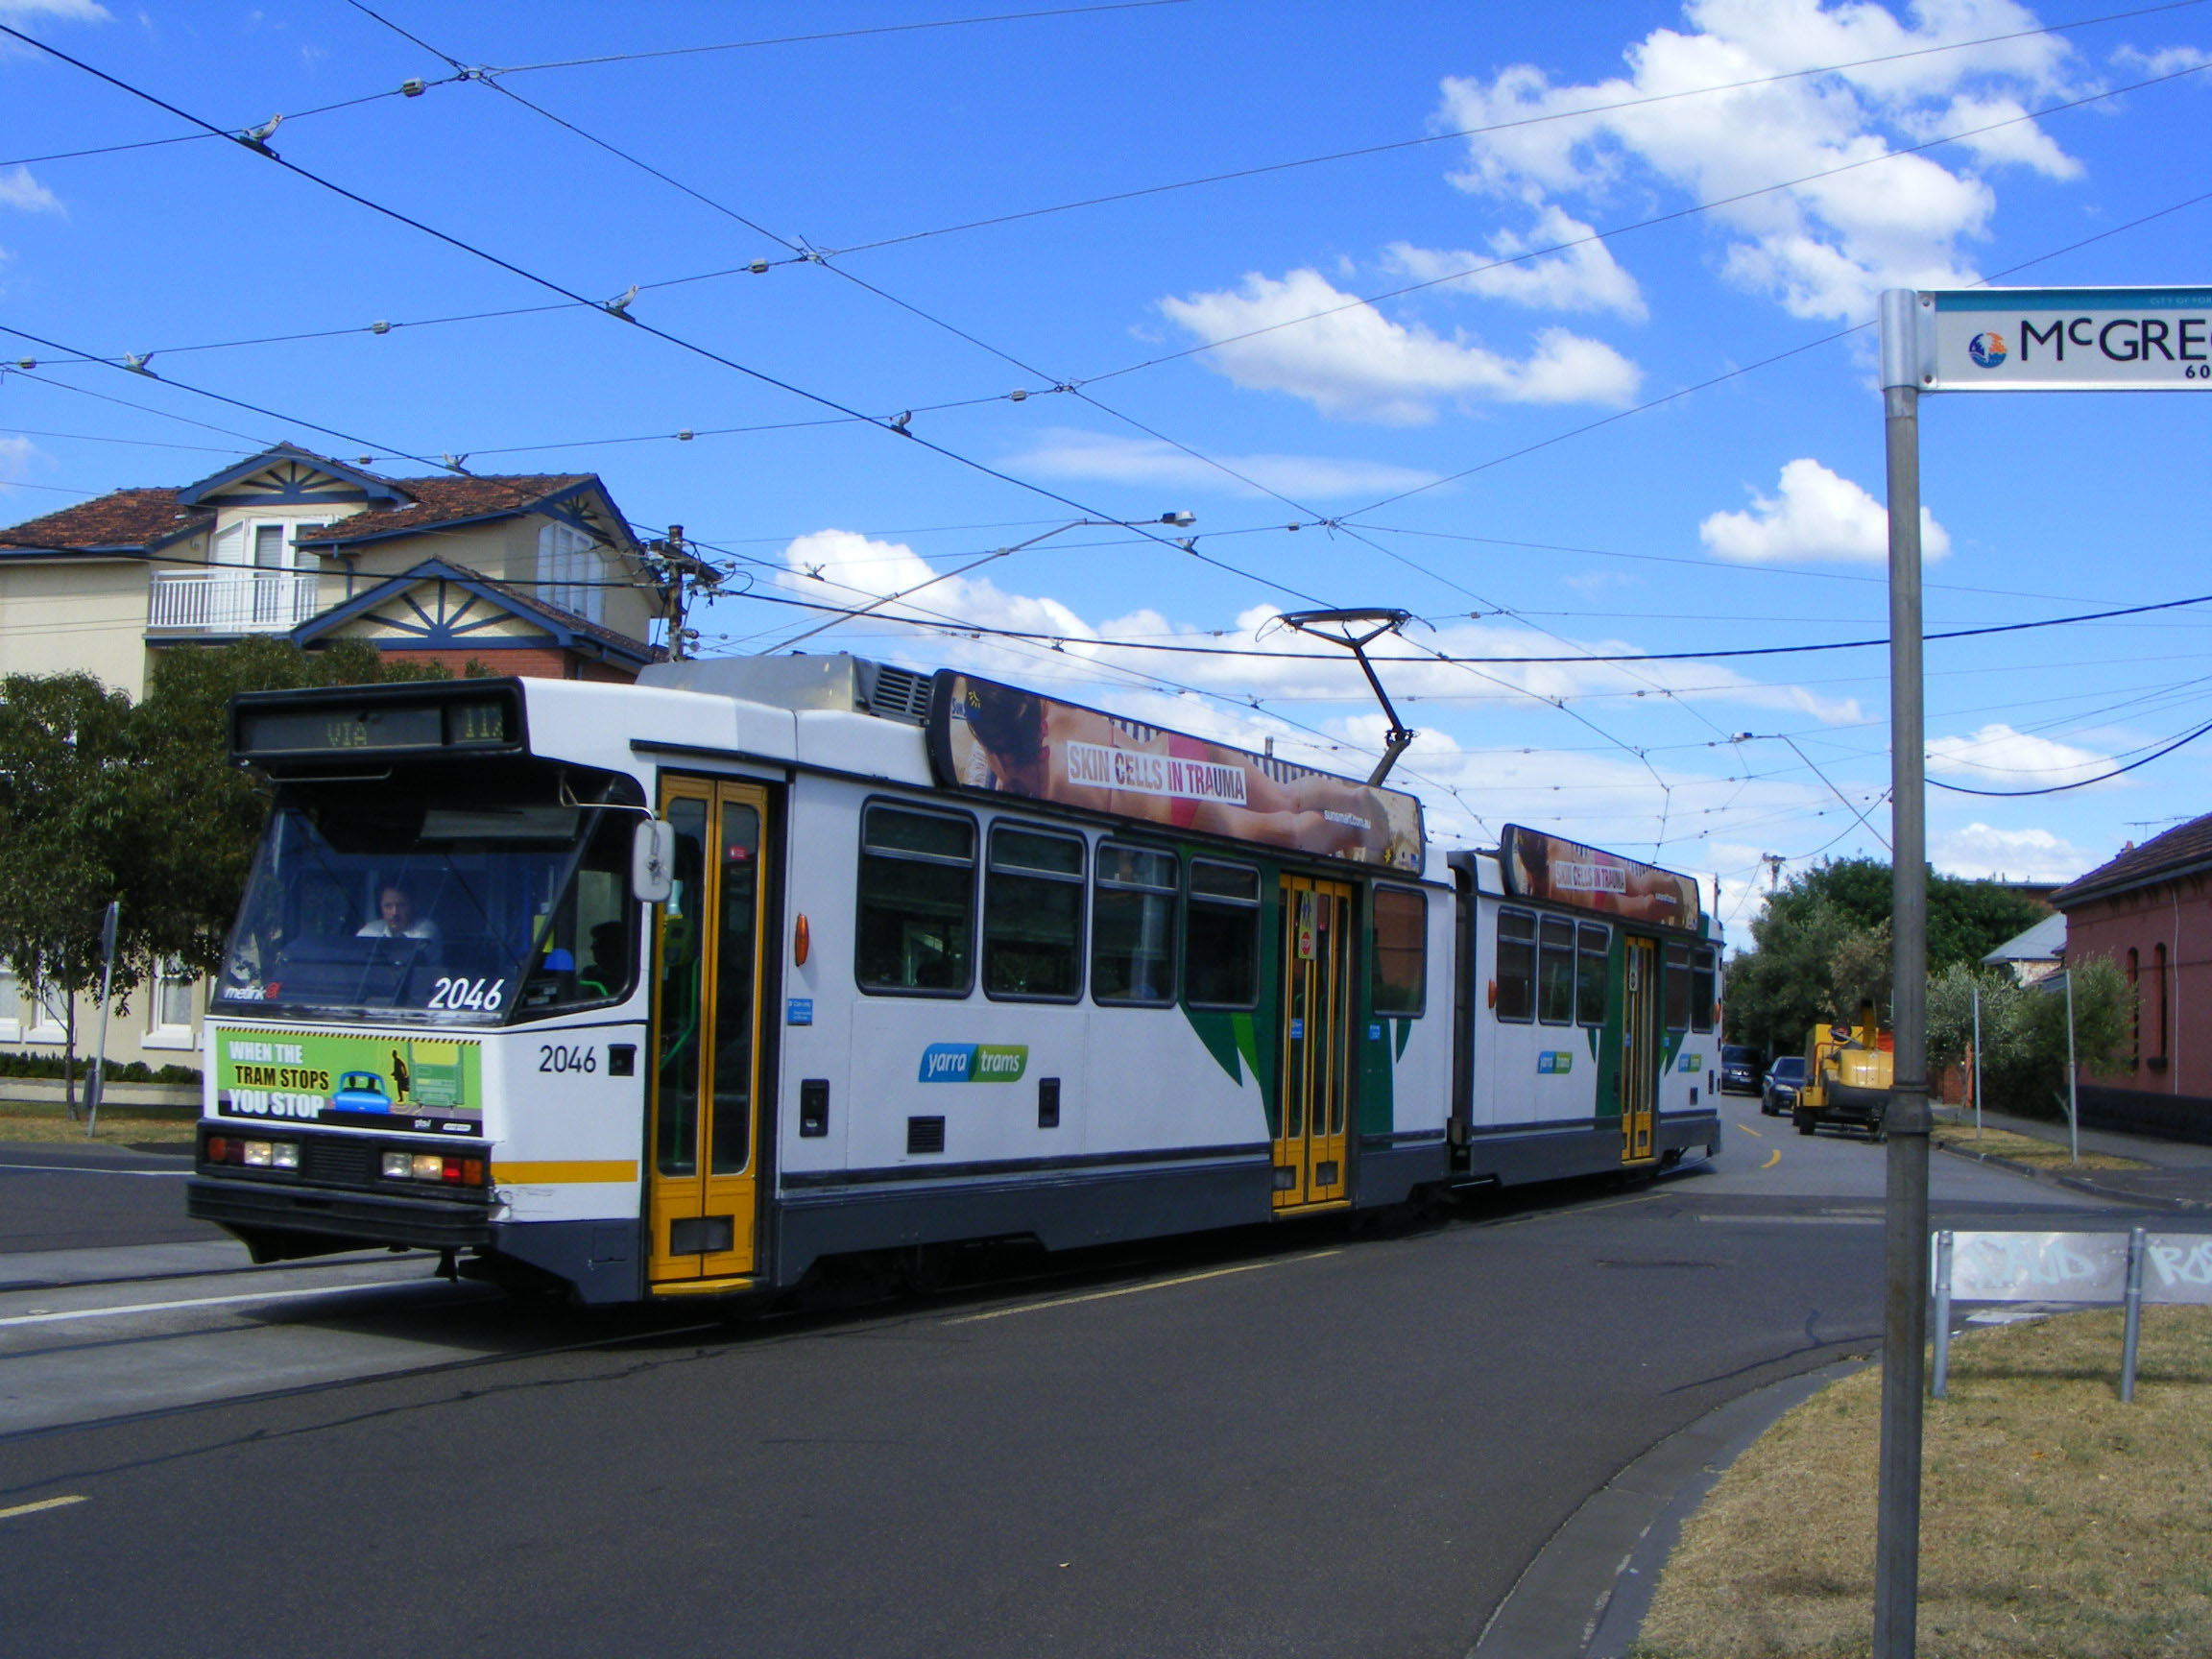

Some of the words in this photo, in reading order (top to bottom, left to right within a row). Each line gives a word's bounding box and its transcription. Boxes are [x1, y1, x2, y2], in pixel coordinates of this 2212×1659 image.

[2020, 318, 2212, 362] McGRE
[2185, 365, 2211, 379] 60
[1068, 745, 1110, 783] SKIN
[1114, 752, 1164, 791] CELLS
[1167, 760, 1184, 793] IN
[1186, 763, 1245, 801] TRAUMA
[428, 977, 505, 1011] 2046
[228, 1041, 272, 1063] WHEN
[274, 1044, 303, 1065] THE
[540, 1045, 597, 1073] 2046
[927, 1050, 968, 1077] yarra
[980, 1049, 1021, 1072] trams
[235, 1065, 276, 1087] TRAM
[280, 1068, 328, 1091] STOPS
[228, 1088, 269, 1115] YOU
[270, 1091, 325, 1118] STOP
